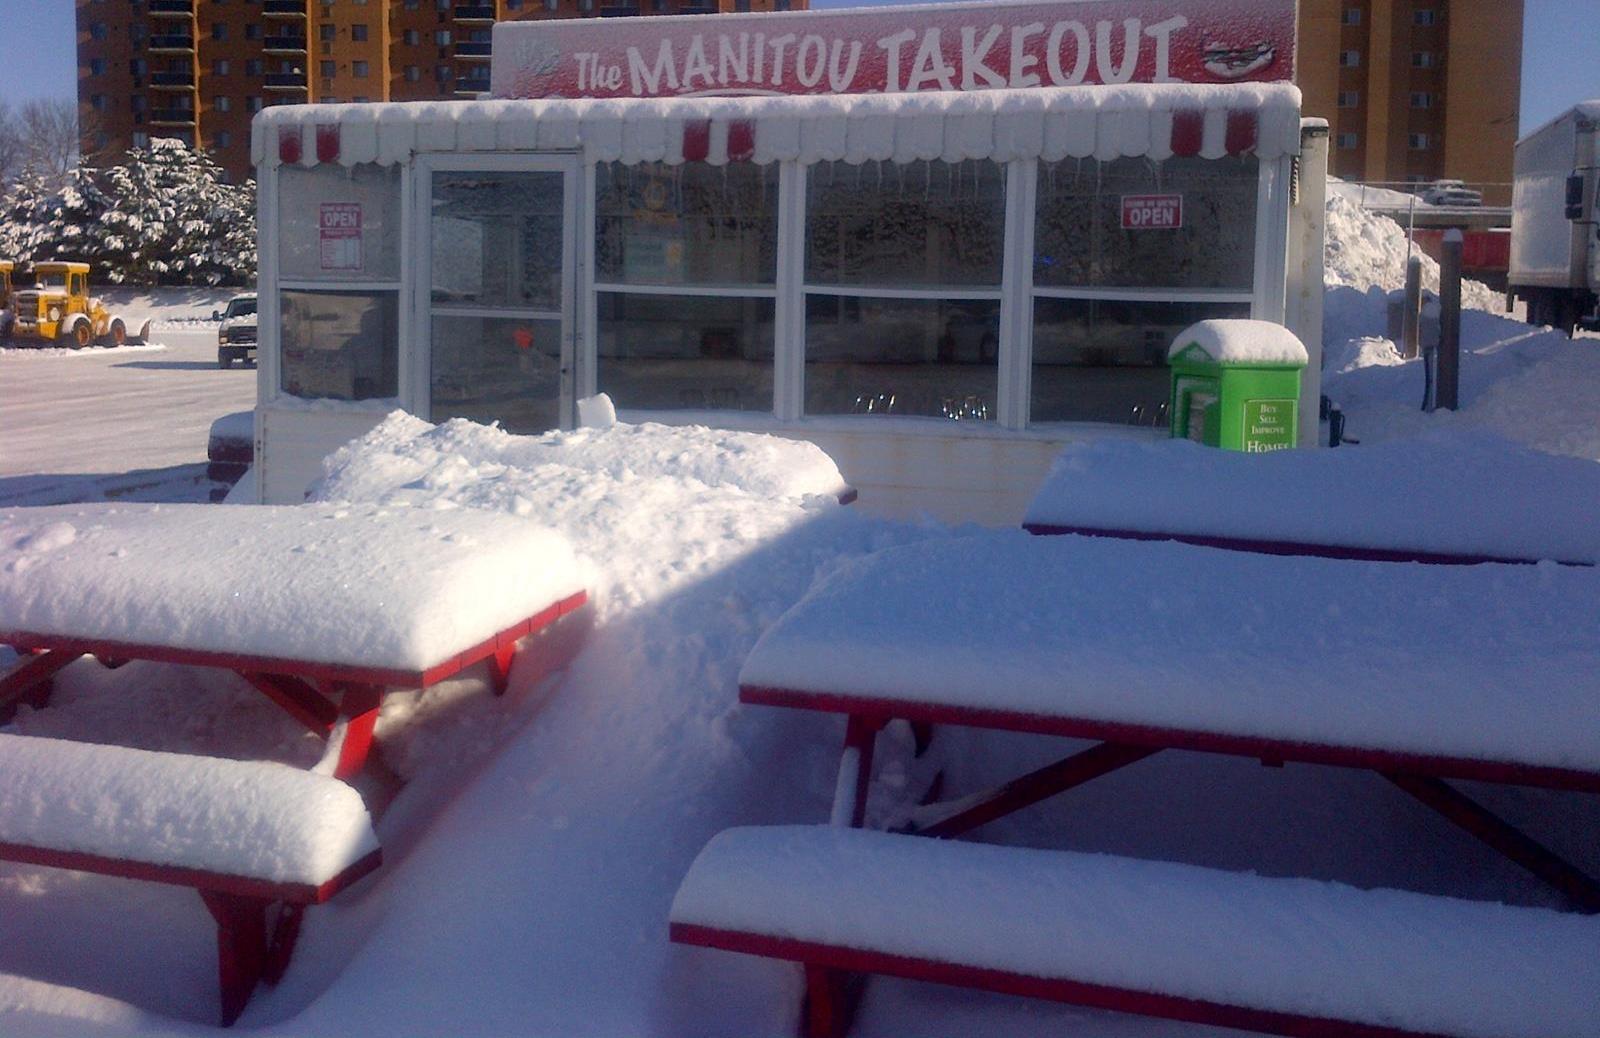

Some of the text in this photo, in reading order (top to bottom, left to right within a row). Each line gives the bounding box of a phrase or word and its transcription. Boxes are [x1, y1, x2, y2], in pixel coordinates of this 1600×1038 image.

[574, 14, 1189, 96] The MANITOU TAKEOUT
[324, 212, 357, 226] OPEN
[1130, 208, 1174, 225] OPEN
